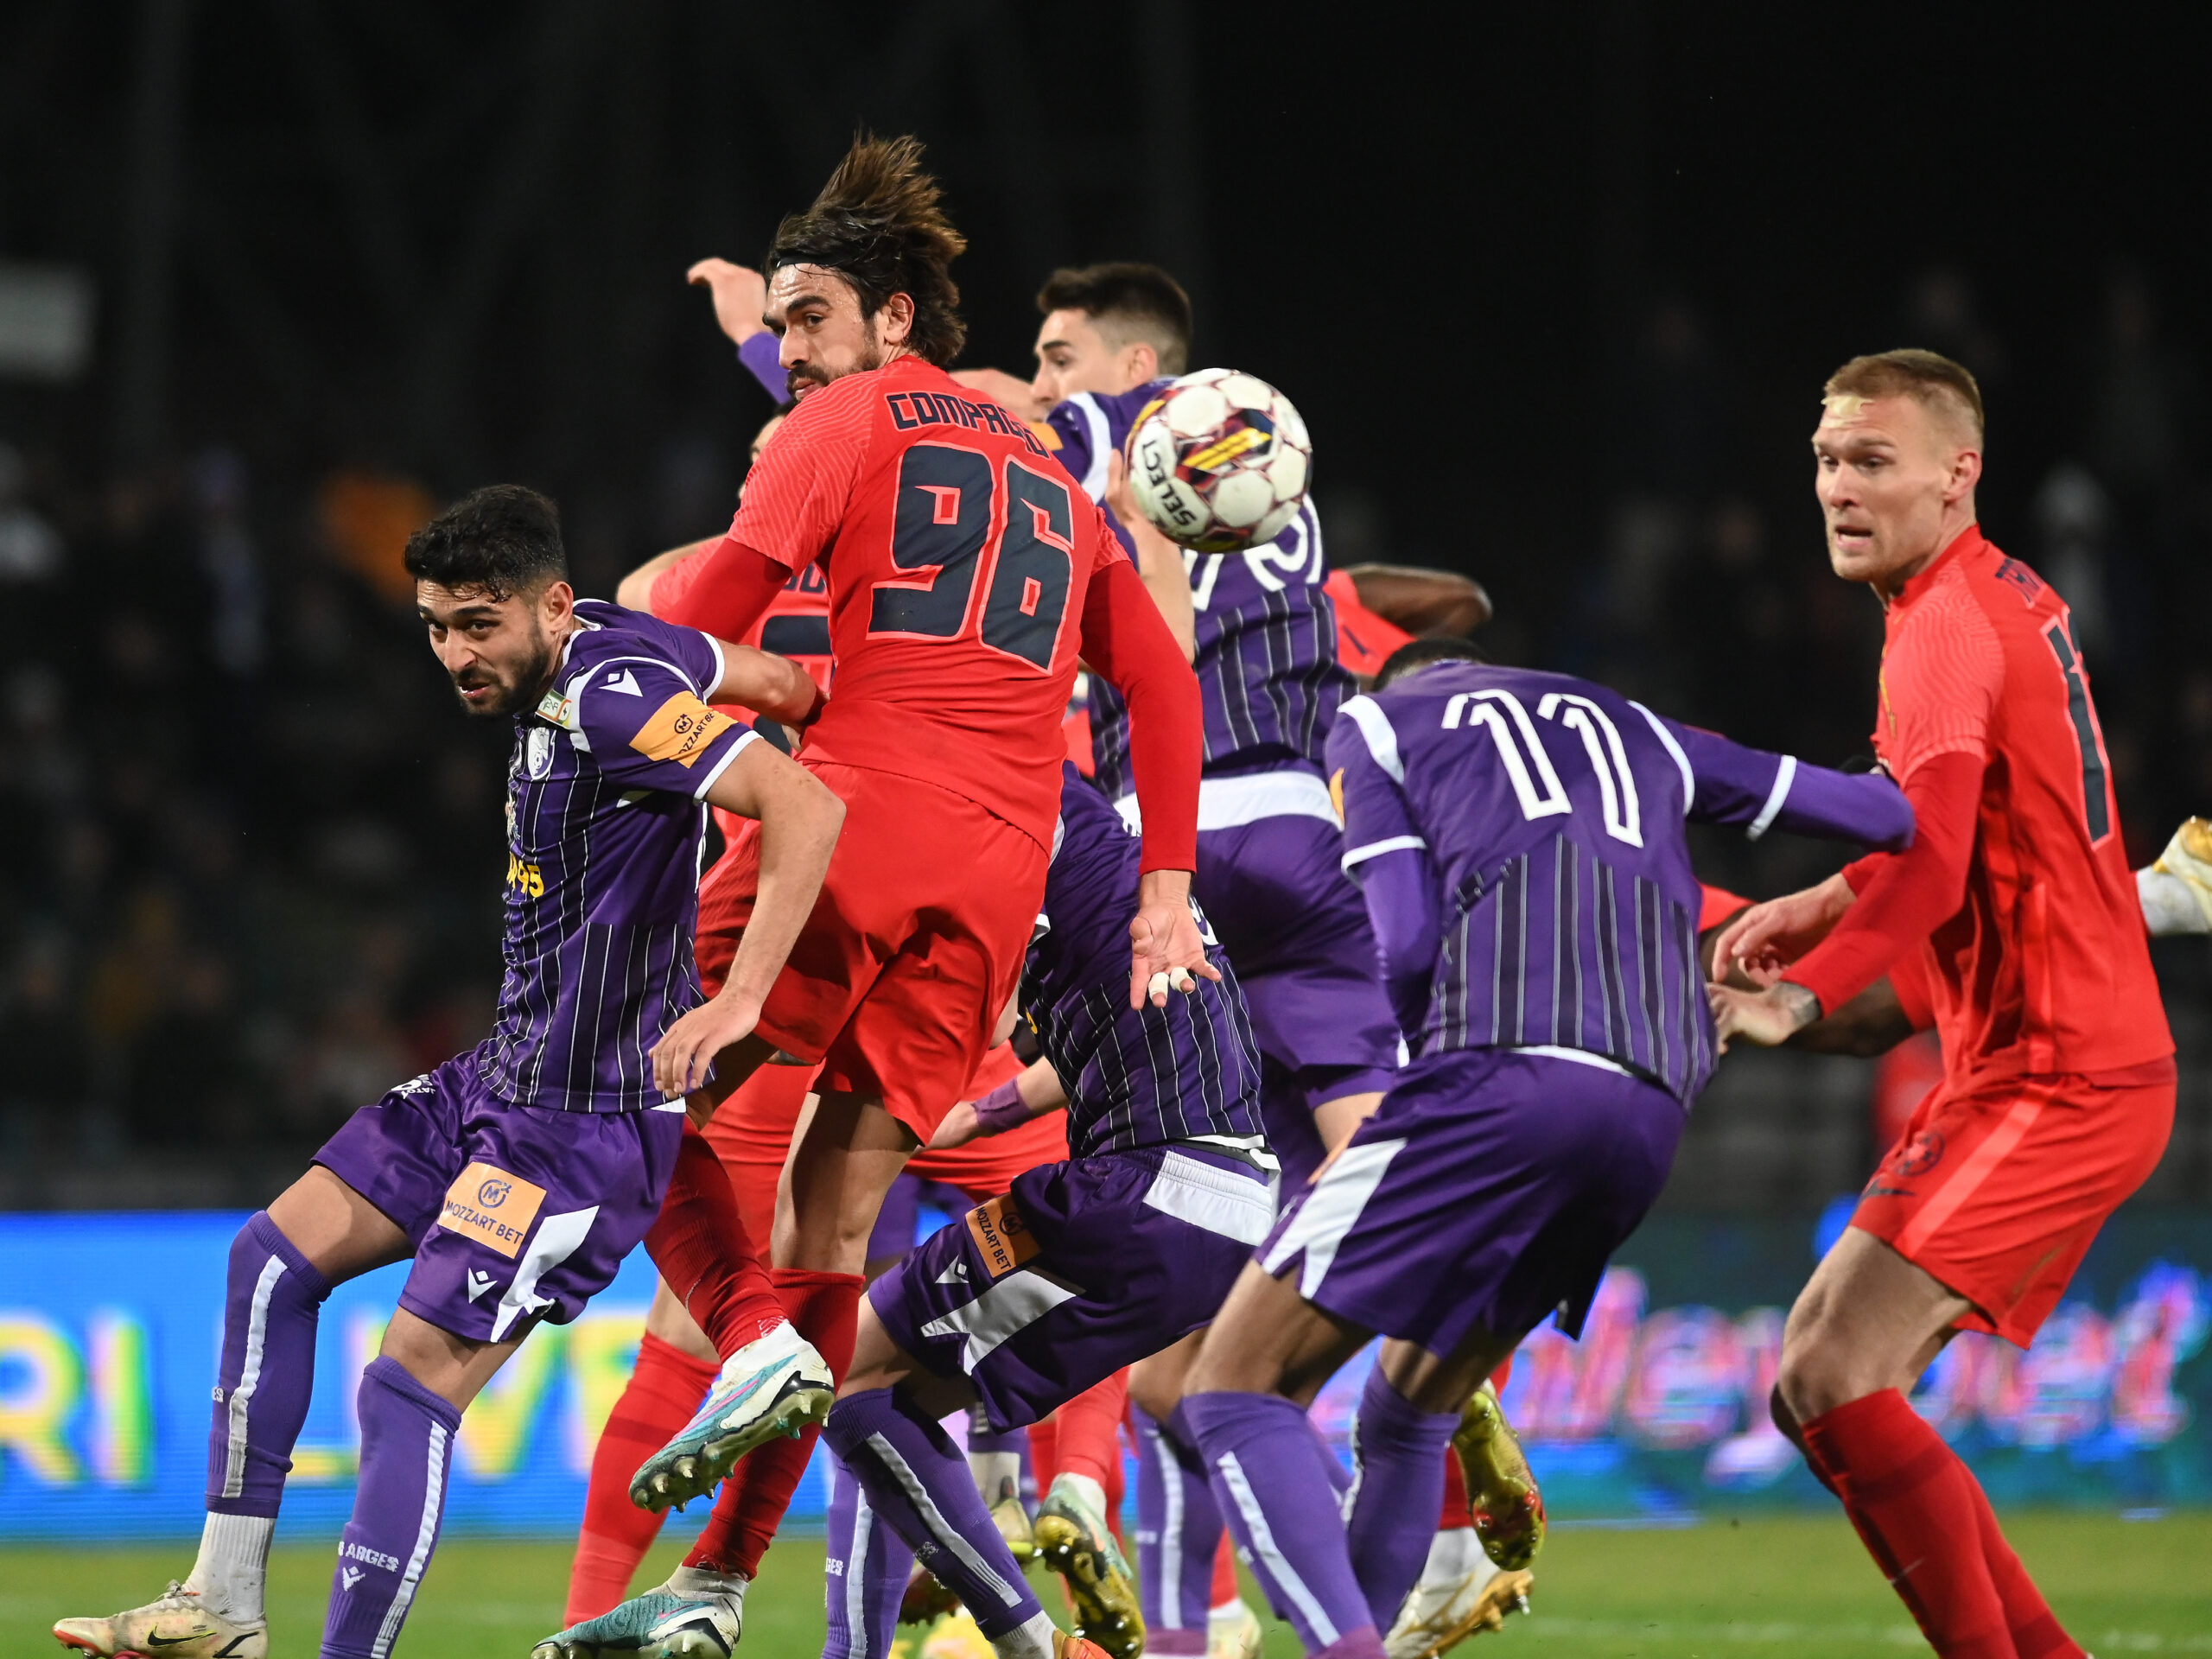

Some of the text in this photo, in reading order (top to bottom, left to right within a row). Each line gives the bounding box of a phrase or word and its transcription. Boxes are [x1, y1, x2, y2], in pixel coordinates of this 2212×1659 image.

[1142, 439, 1198, 526] SELECT
[866, 440, 1074, 675] 96
[678, 719, 708, 755] OZZART
[1441, 689, 1644, 849] 11
[445, 1200, 524, 1244] MOZZART BET
[976, 1206, 1012, 1270] MOZZART BET
